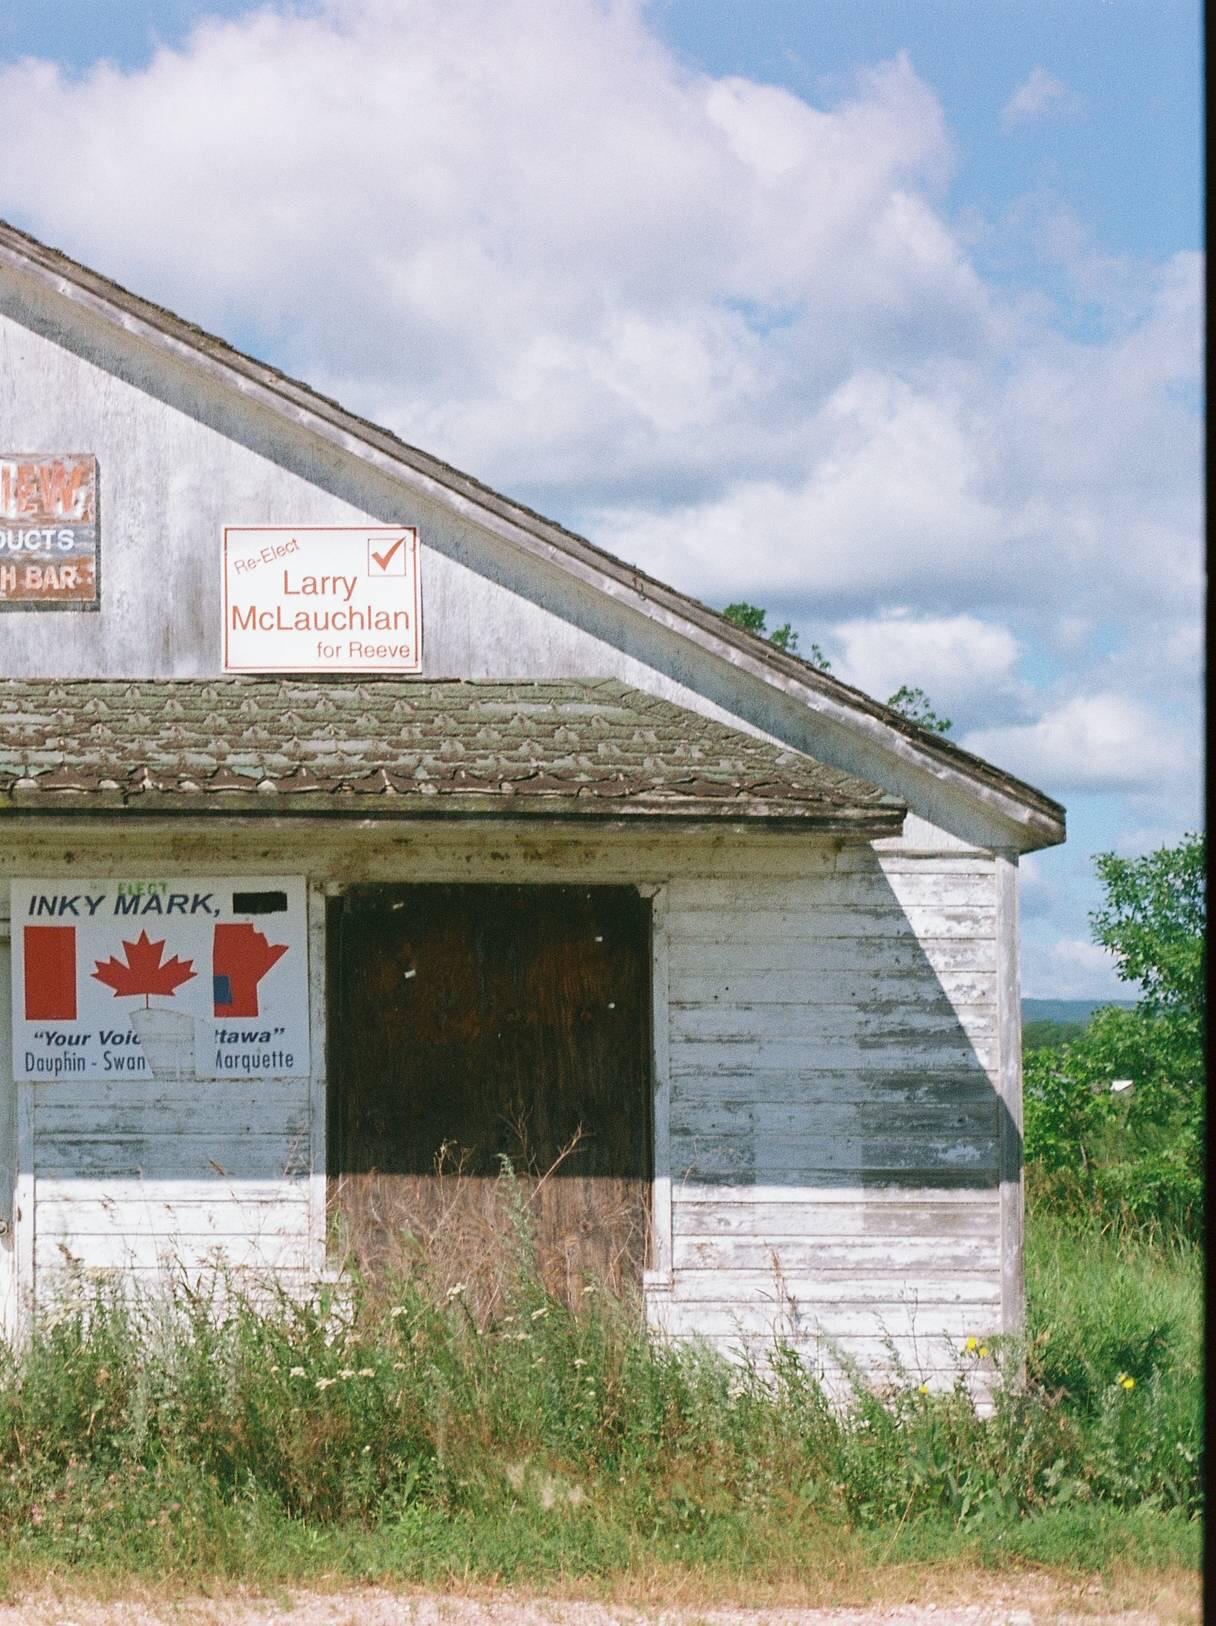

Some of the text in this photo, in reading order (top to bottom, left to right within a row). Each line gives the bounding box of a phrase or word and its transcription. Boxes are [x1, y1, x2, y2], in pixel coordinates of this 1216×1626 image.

[233, 537, 301, 575] Re-Elect
[25, 564, 78, 590] BAR
[283, 570, 358, 602] Larry
[232, 605, 410, 631] McLauchlan
[317, 641, 410, 658] for Reeve
[28, 893, 222, 918] INKY MARK,
[99, 1029, 142, 1047] Voic
[24, 1051, 86, 1077] Dauphin
[103, 1051, 146, 1072] Swan
